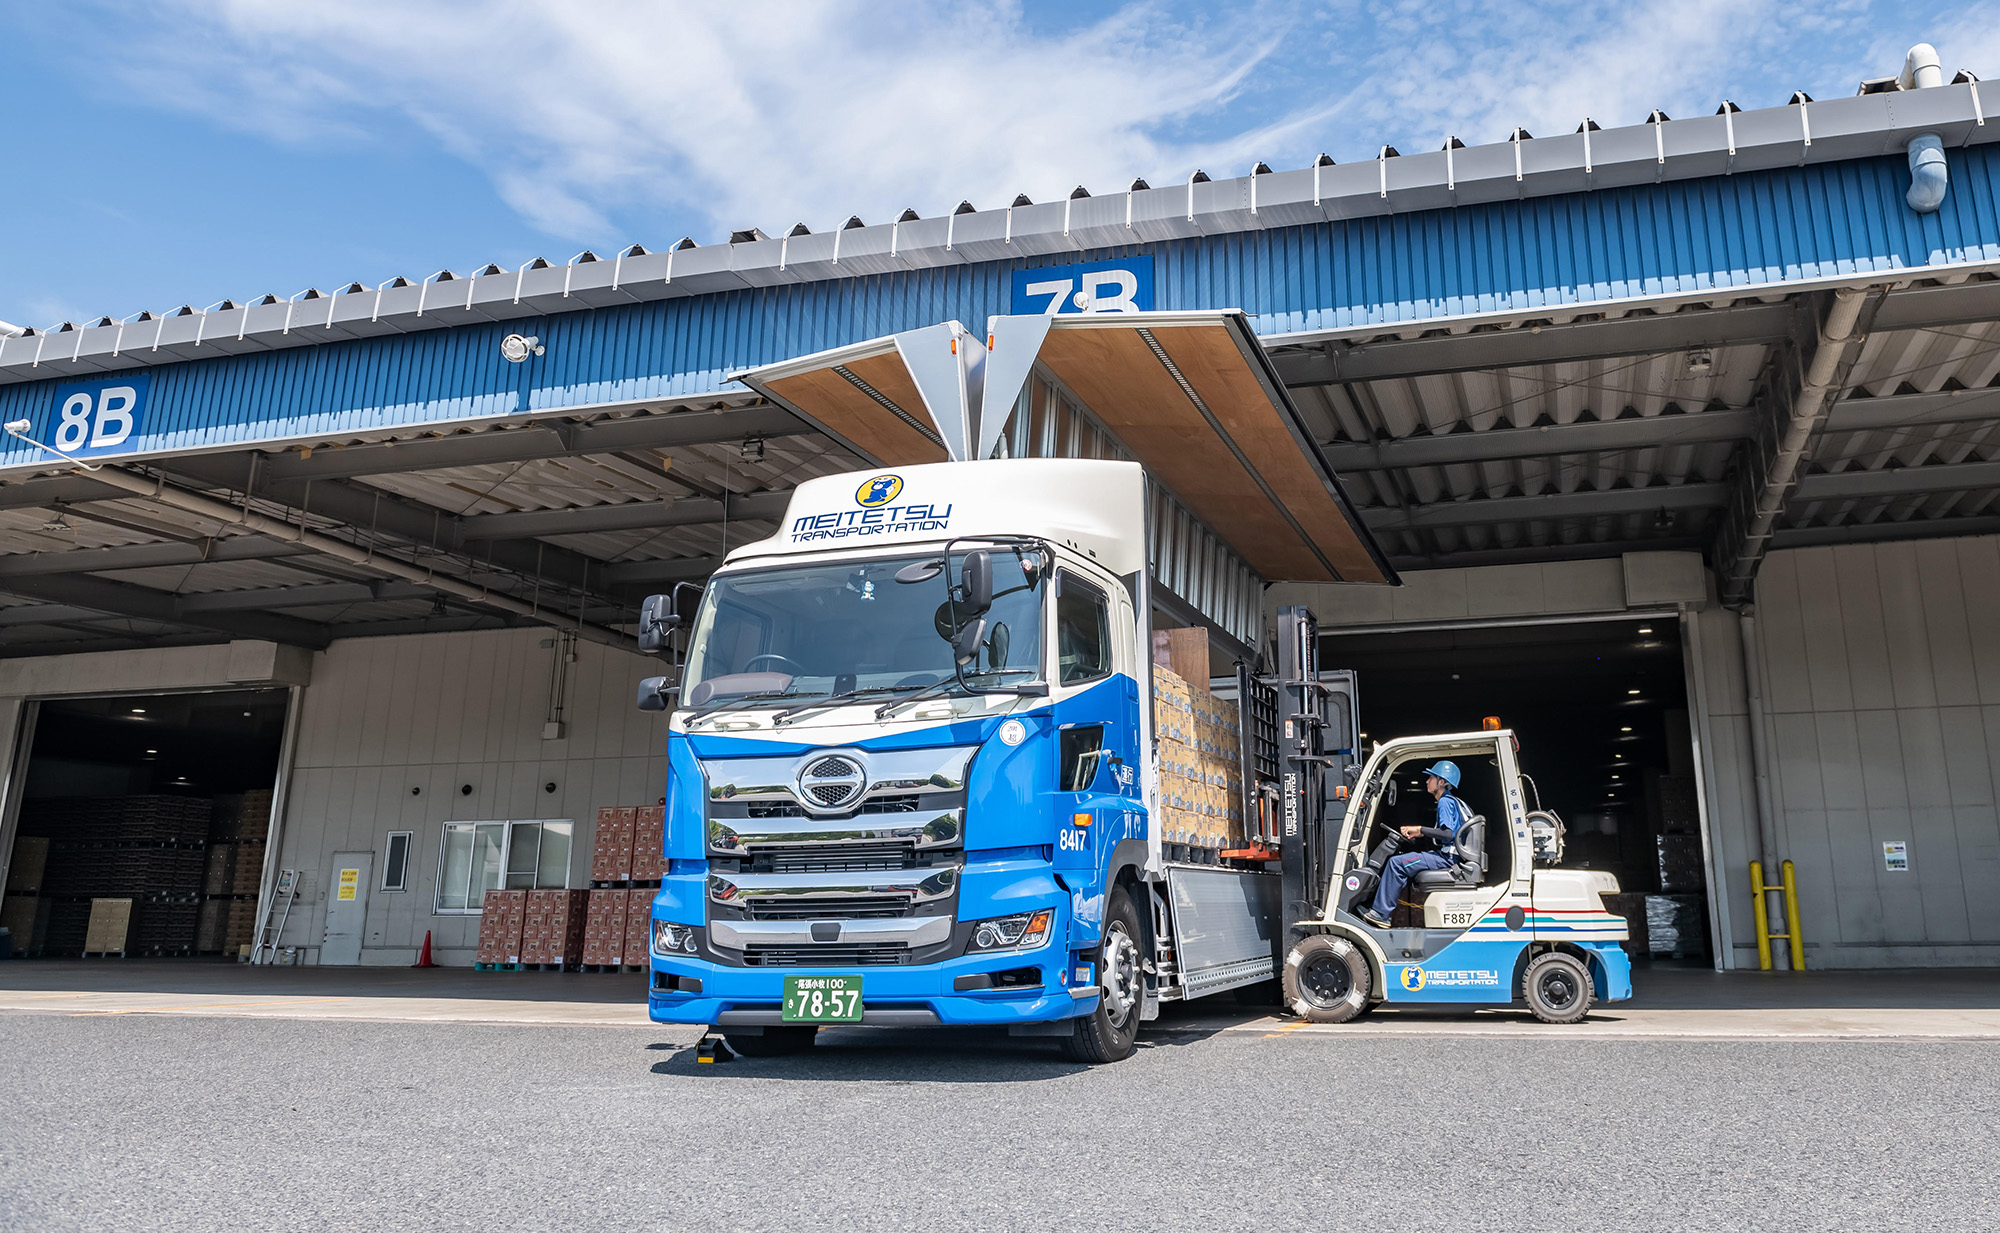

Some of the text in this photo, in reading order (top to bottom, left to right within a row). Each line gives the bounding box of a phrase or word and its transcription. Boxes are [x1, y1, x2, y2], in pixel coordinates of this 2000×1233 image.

[1026, 269, 1140, 313] 7B
[55, 386, 137, 452] 8B
[791, 520, 948, 543] TRANSPORTATION
[793, 504, 952, 532] MEITETSU
[1284, 773, 1293, 837] MEITETSU
[1059, 829, 1087, 851] 8417
[1443, 913, 1472, 924] F887
[1426, 970, 1498, 979] MEITETSU
[797, 990, 859, 1017] 78-57
